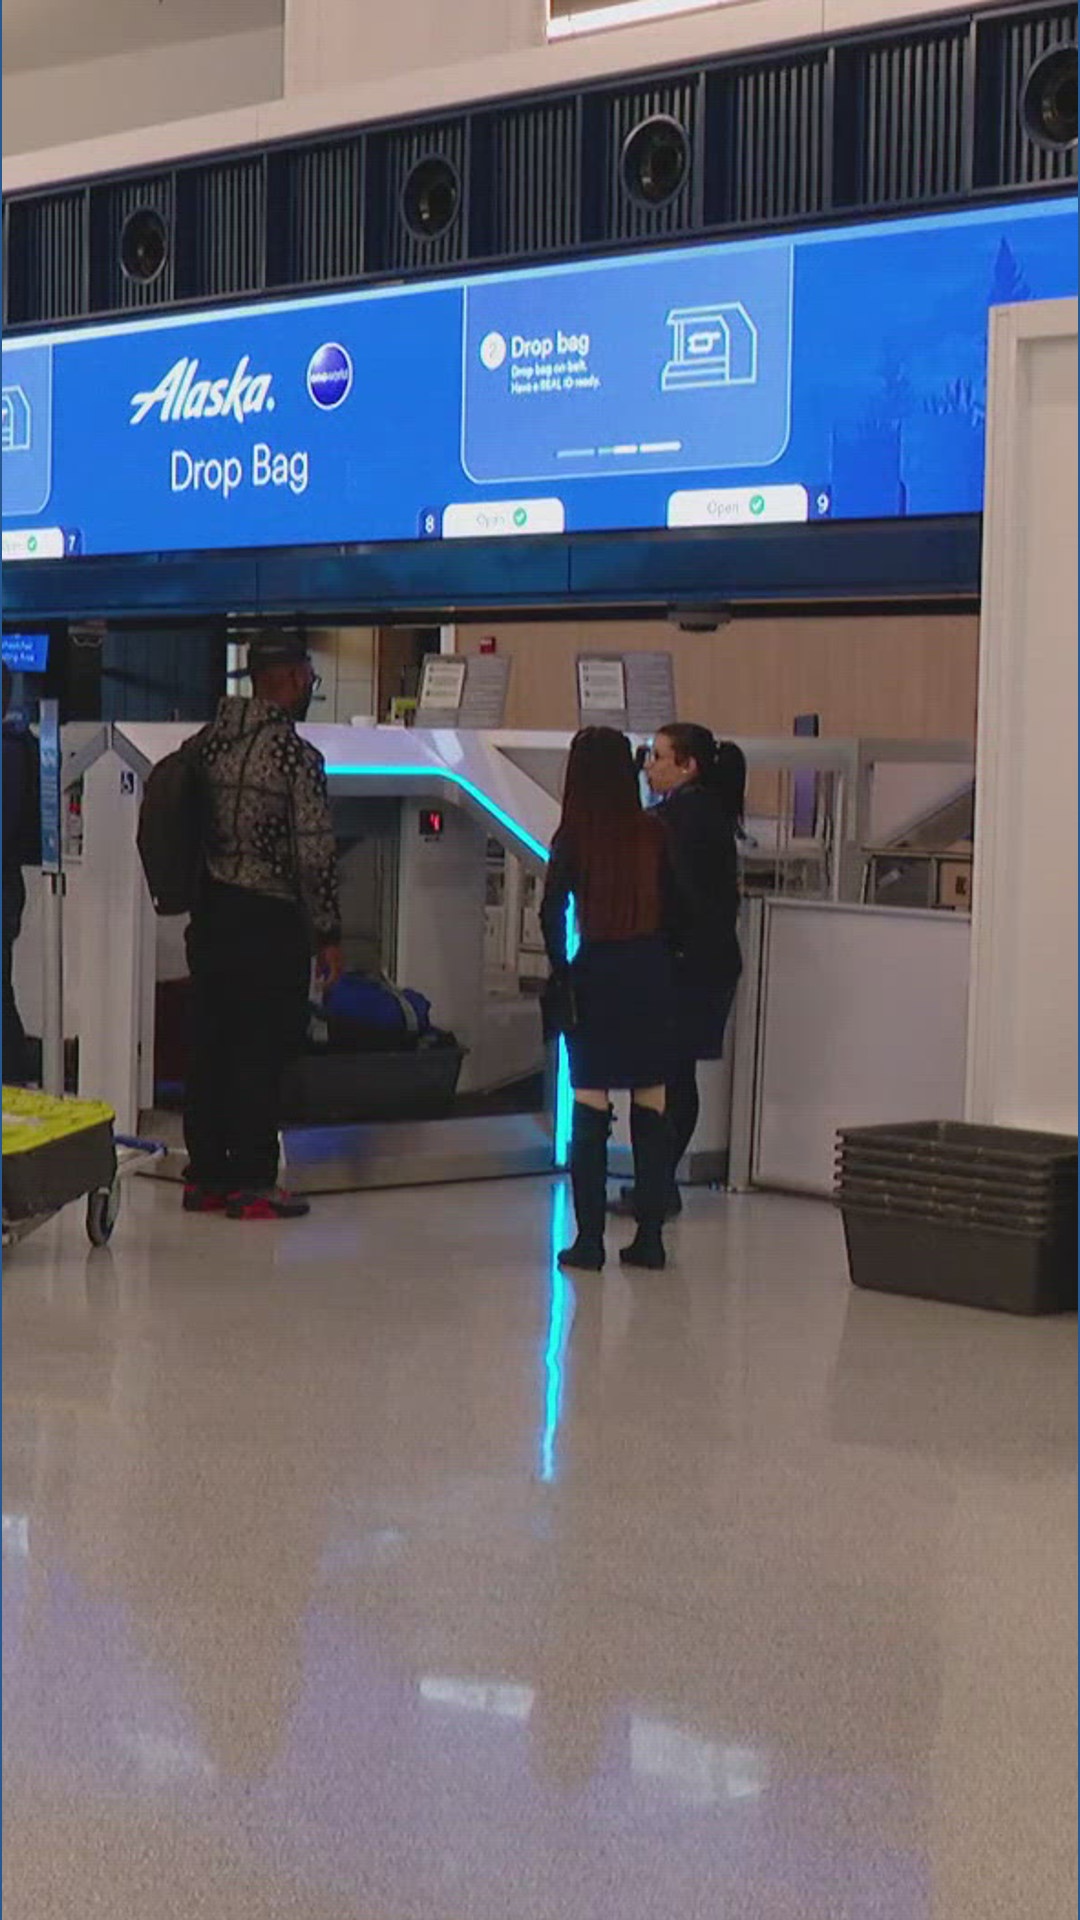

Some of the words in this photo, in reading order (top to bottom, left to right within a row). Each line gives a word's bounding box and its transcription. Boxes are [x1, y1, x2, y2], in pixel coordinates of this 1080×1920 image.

[511, 335, 553, 361] Drop
[557, 330, 590, 357] bag
[511, 363, 534, 380] Drop
[535, 362, 553, 378] bag
[553, 363, 566, 374] on
[563, 376, 573, 389] ID
[171, 450, 243, 499] Drop
[252, 443, 309, 494] Bag
[706, 499, 739, 517] Open
[816, 493, 829, 514] 9
[425, 514, 434, 534] 8
[68, 535, 76, 551] 7
